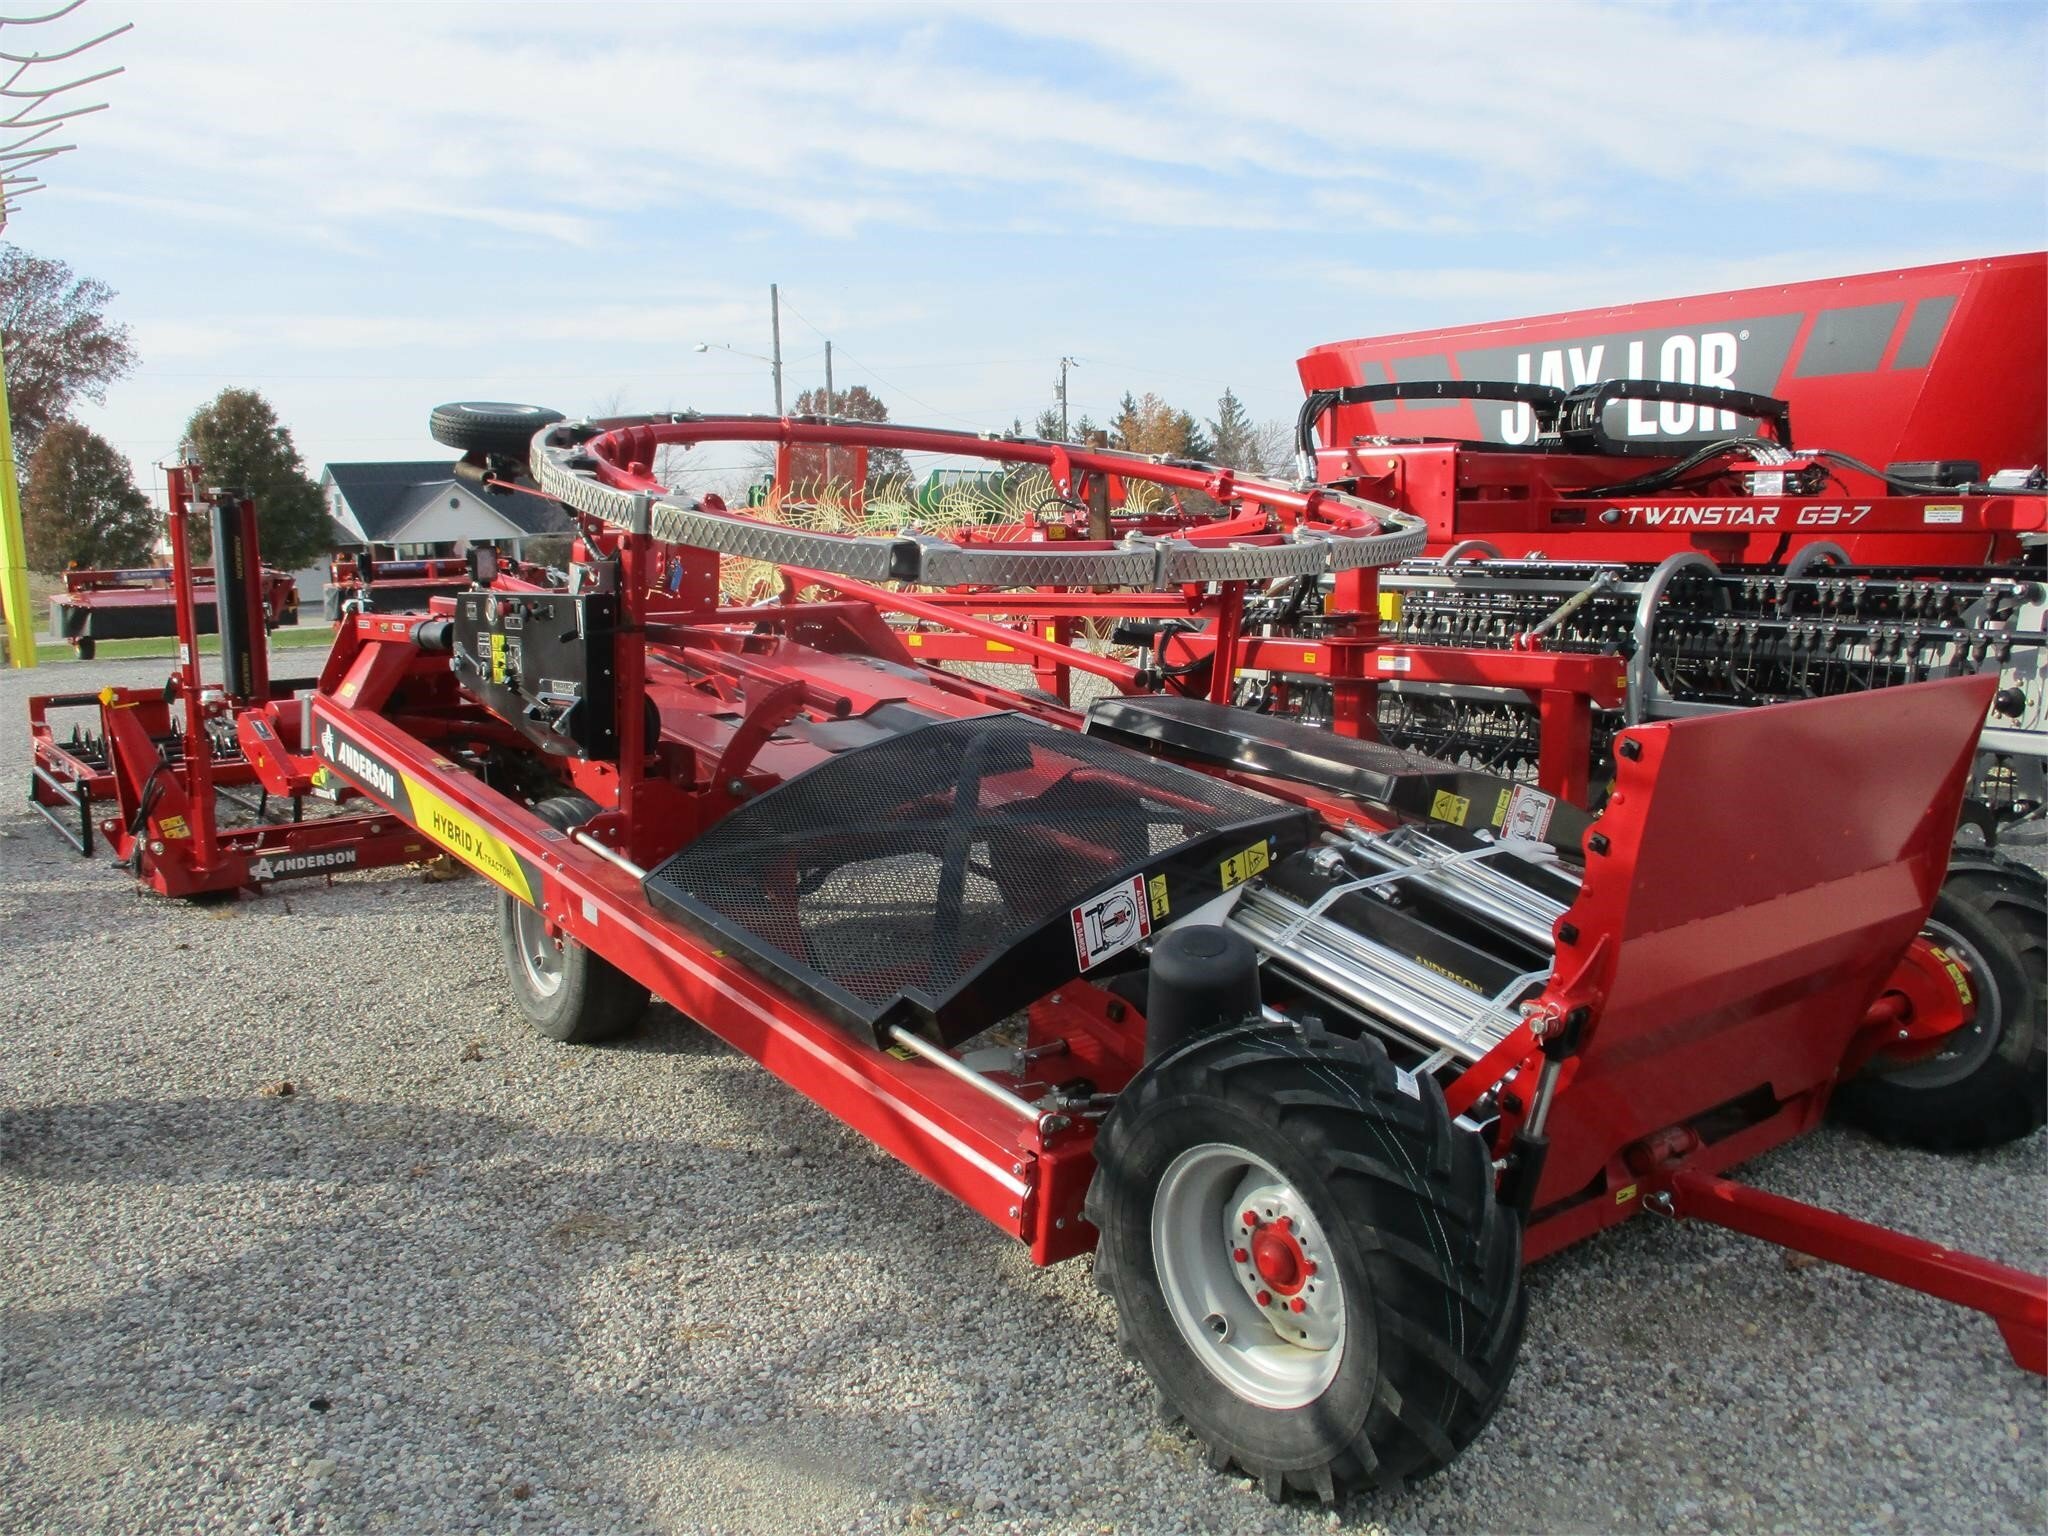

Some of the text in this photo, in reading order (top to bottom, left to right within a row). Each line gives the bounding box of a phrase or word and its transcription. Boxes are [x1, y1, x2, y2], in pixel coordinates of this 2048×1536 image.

[1437, 383, 1443, 395] 2
[1476, 383, 1482, 394] 3
[1513, 384, 1519, 395] 4
[1627, 505, 1872, 526] TWINSTAR G3-7
[337, 741, 395, 800] ANDERSON
[432, 810, 472, 852] HYBRID
[273, 850, 356, 873] ANDERSON
[1137, 893, 1147, 926] DANGER
[1075, 926, 1088, 959] DANGER
[1415, 955, 1484, 994] ANDERSON
